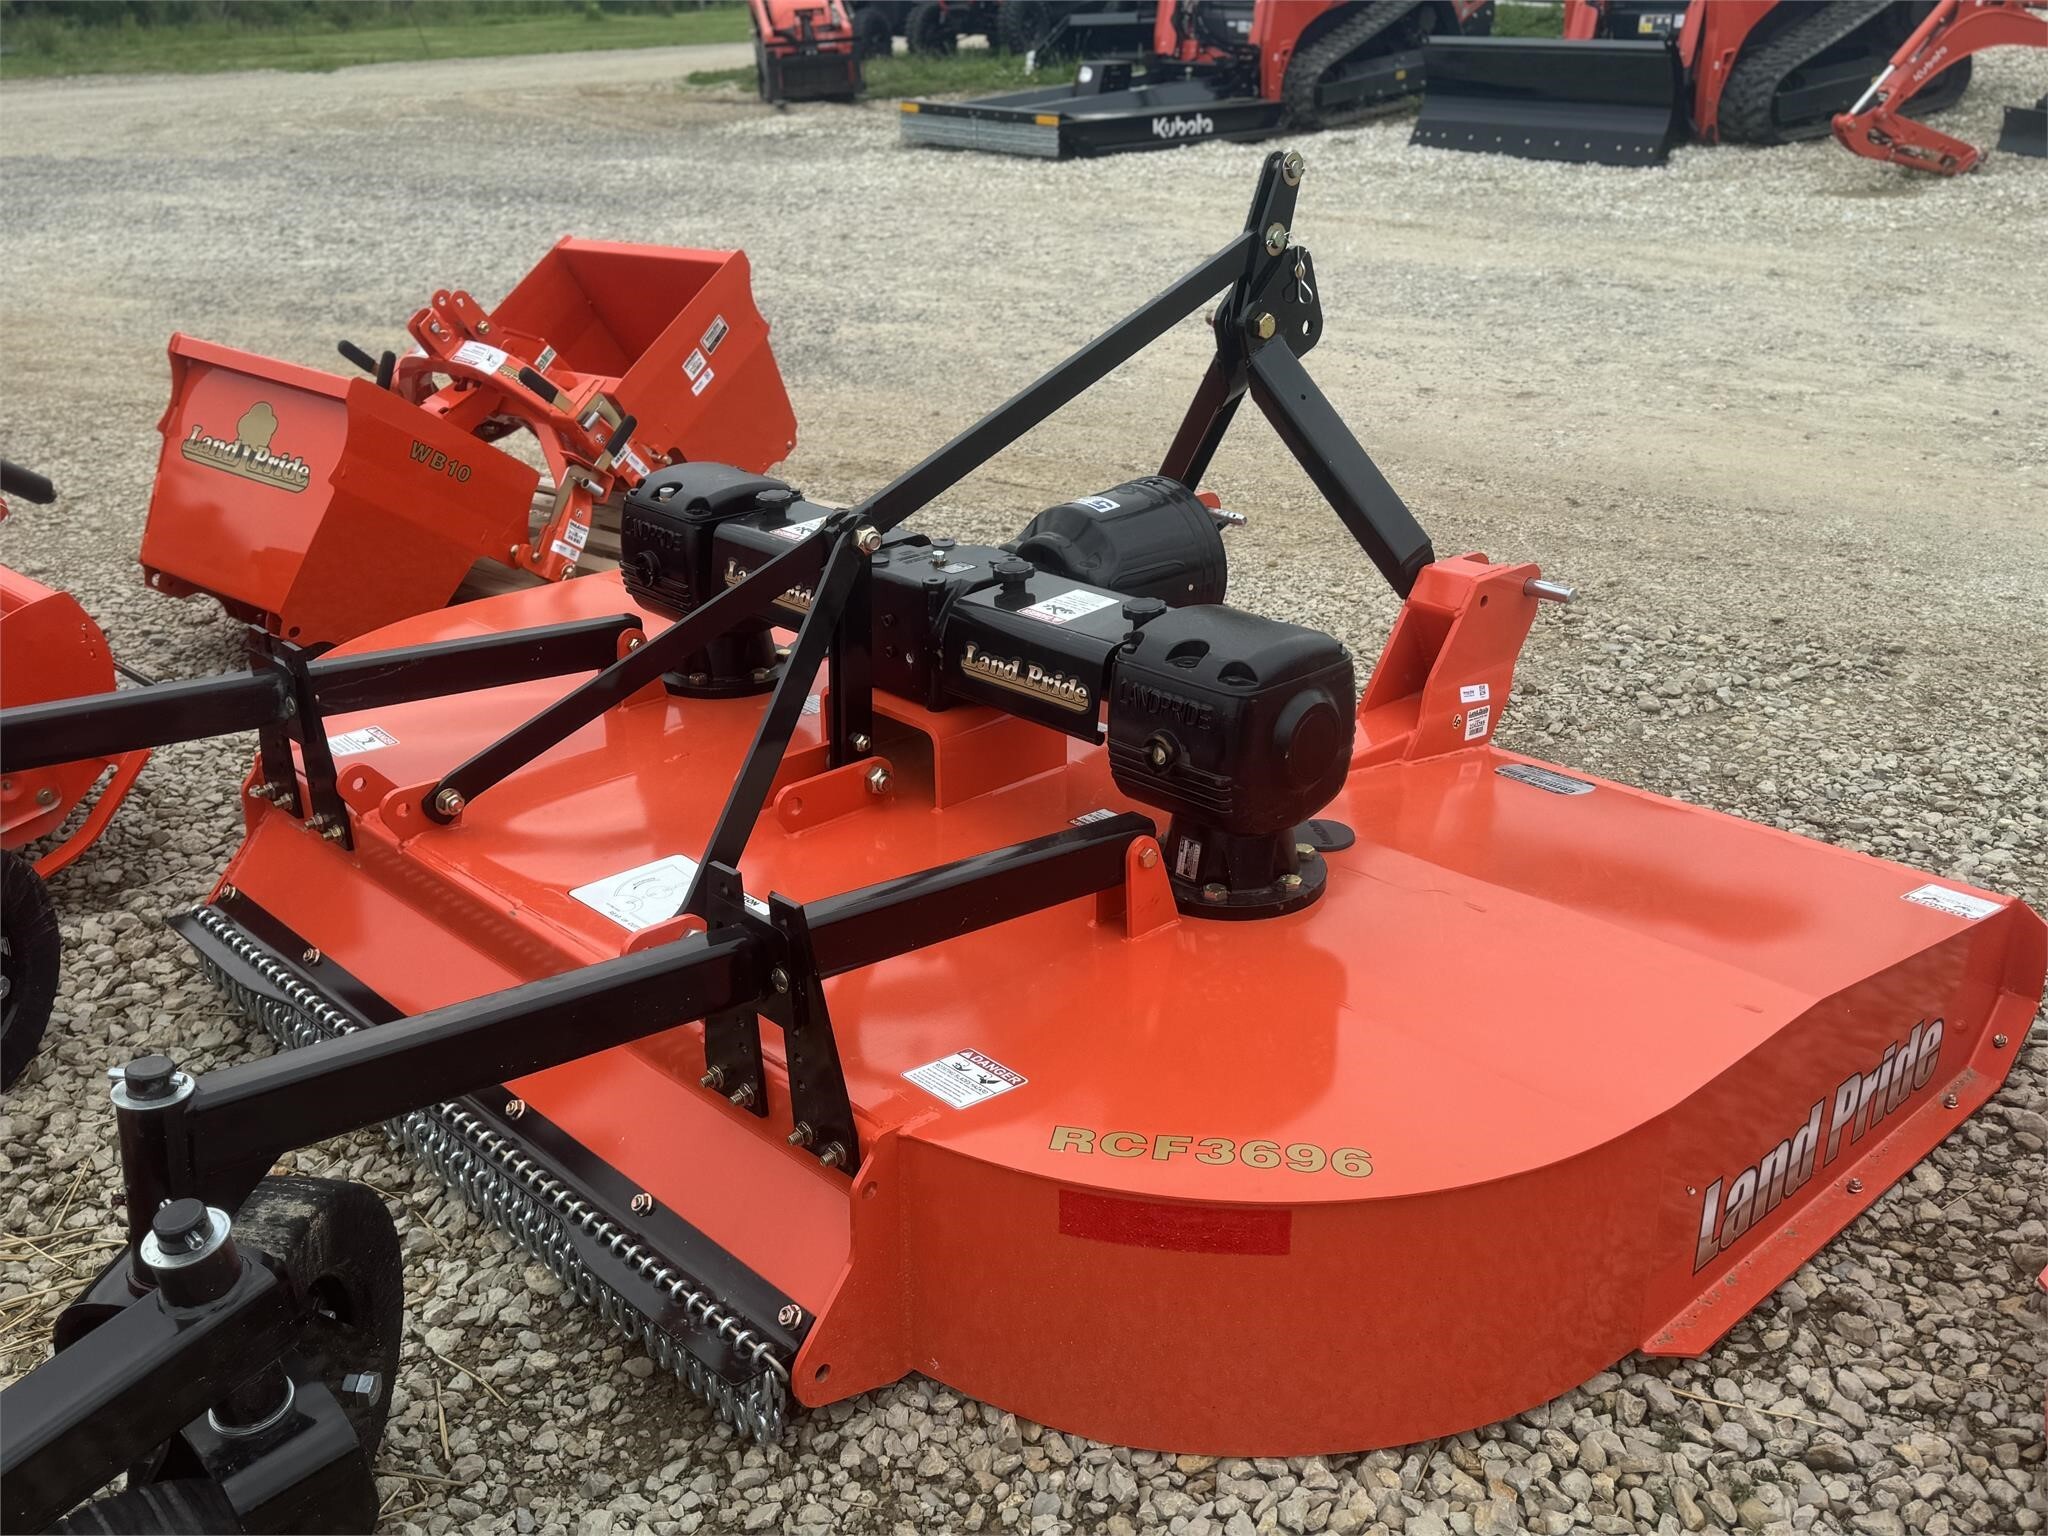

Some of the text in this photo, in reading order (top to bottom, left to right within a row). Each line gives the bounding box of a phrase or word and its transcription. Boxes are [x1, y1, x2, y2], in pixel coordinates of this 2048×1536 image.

[1152, 113, 1214, 139] Kubota
[187, 425, 310, 484] Land Pride
[410, 440, 472, 482] WB10
[963, 644, 1088, 704] Land Pride
[970, 1054, 1021, 1084] DANGER
[1048, 1125, 1374, 1178] RCF3696
[1693, 1018, 1944, 1276] Land Pride
